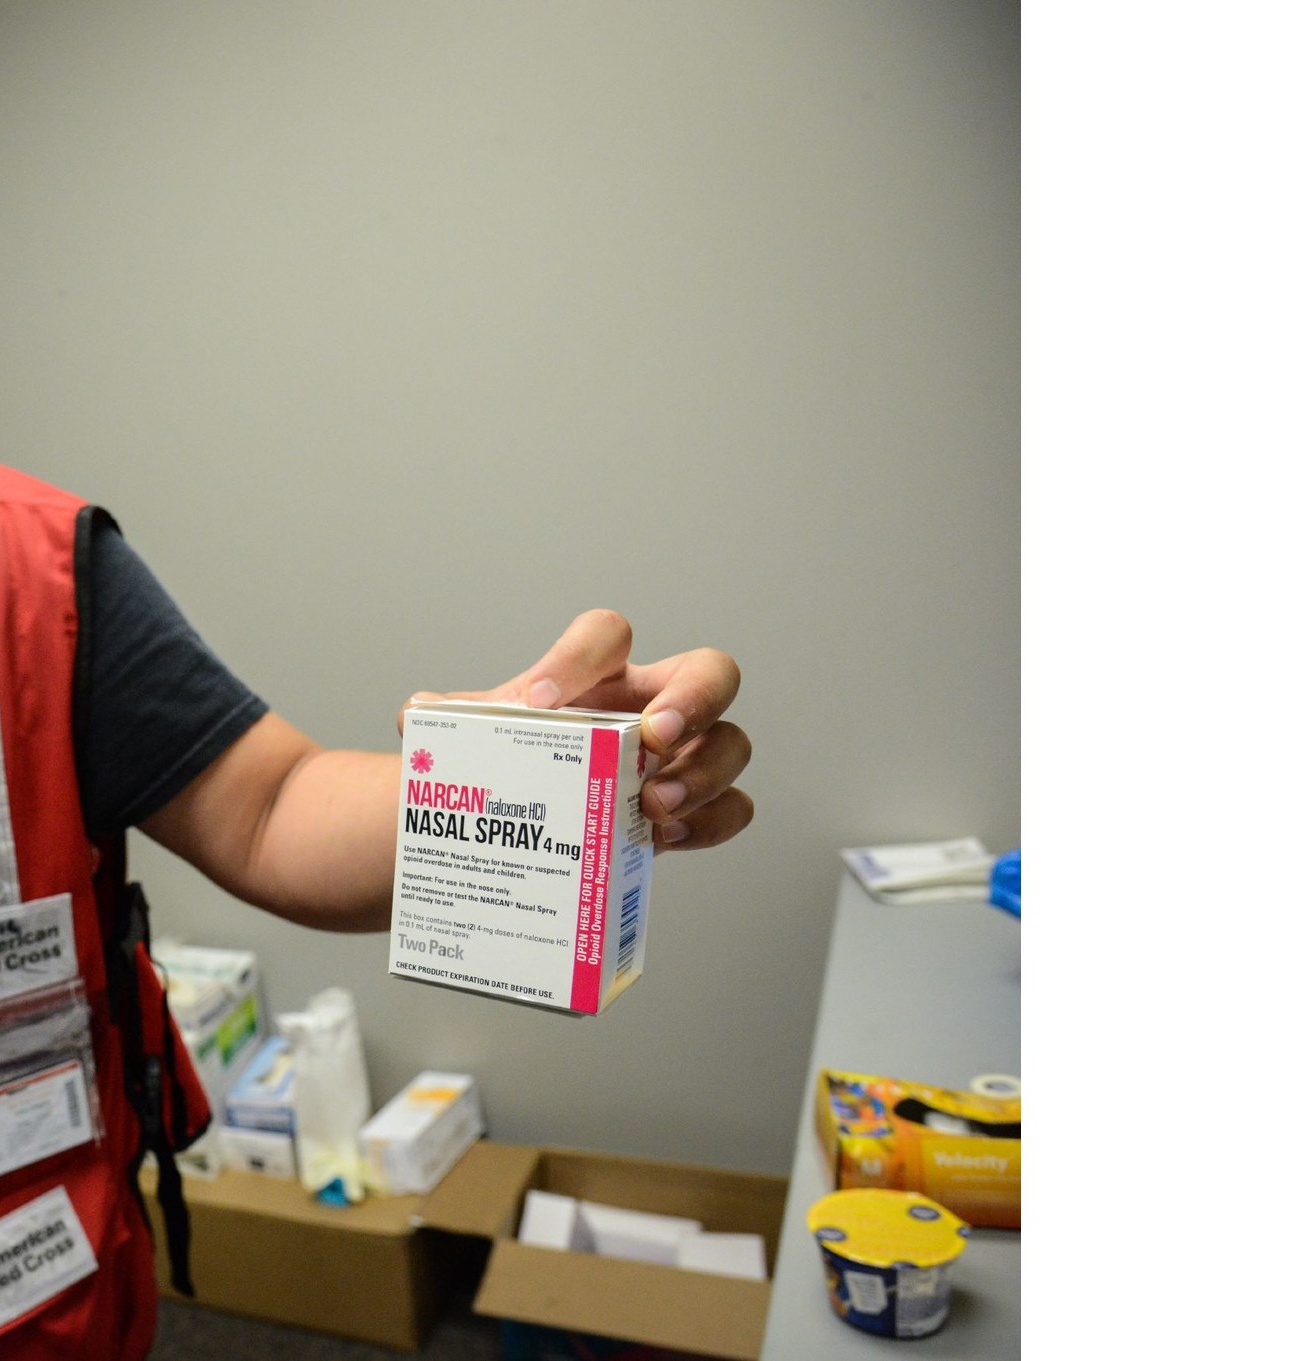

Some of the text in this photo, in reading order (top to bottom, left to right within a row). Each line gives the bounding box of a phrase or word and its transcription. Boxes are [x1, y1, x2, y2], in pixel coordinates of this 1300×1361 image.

[514, 729, 543, 738] intranasal
[544, 732, 560, 741] spray
[561, 734, 571, 742] per
[570, 743, 583, 751] only
[554, 753, 582, 764] Rx Only
[486, 797, 526, 819] (naloxone
[405, 808, 581, 860] NASAL SPRAY 4 mg
[404, 845, 416, 853] Use
[451, 853, 469, 861] Nasal
[471, 856, 489, 866] Spray
[502, 861, 524, 869] known
[535, 866, 570, 876] suspected
[404, 855, 422, 863] opioid
[424, 859, 452, 868] overdose
[462, 864, 481, 872] adults
[497, 869, 526, 879] children.
[577, 778, 601, 961] OPEN HERE FOR QUICK START GUIDE
[588, 778, 613, 965] Opioid Overdose Response Instructions
[402, 871, 433, 882] Important:
[496, 888, 512, 896] only.
[416, 895, 433, 904] ready
[422, 887, 445, 896] remove
[455, 892, 467, 900] test
[516, 902, 535, 911] Nasal
[537, 905, 557, 916] Spray
[400, 911, 412, 919] This
[426, 916, 452, 926] contains
[477, 925, 493, 935] 4-mg
[495, 928, 514, 937] doses
[524, 934, 554, 944] naloxone
[434, 927, 450, 935] nasal
[452, 931, 470, 940] spray.
[5, 944, 61, 971] Cross
[398, 933, 464, 960] Two Pack
[396, 961, 554, 999] CHECK PRODUCT EXPIRATION DATE BEFORE USE.
[933, 1152, 1009, 1173] Velocity
[23, 1236, 74, 1272] Cross
